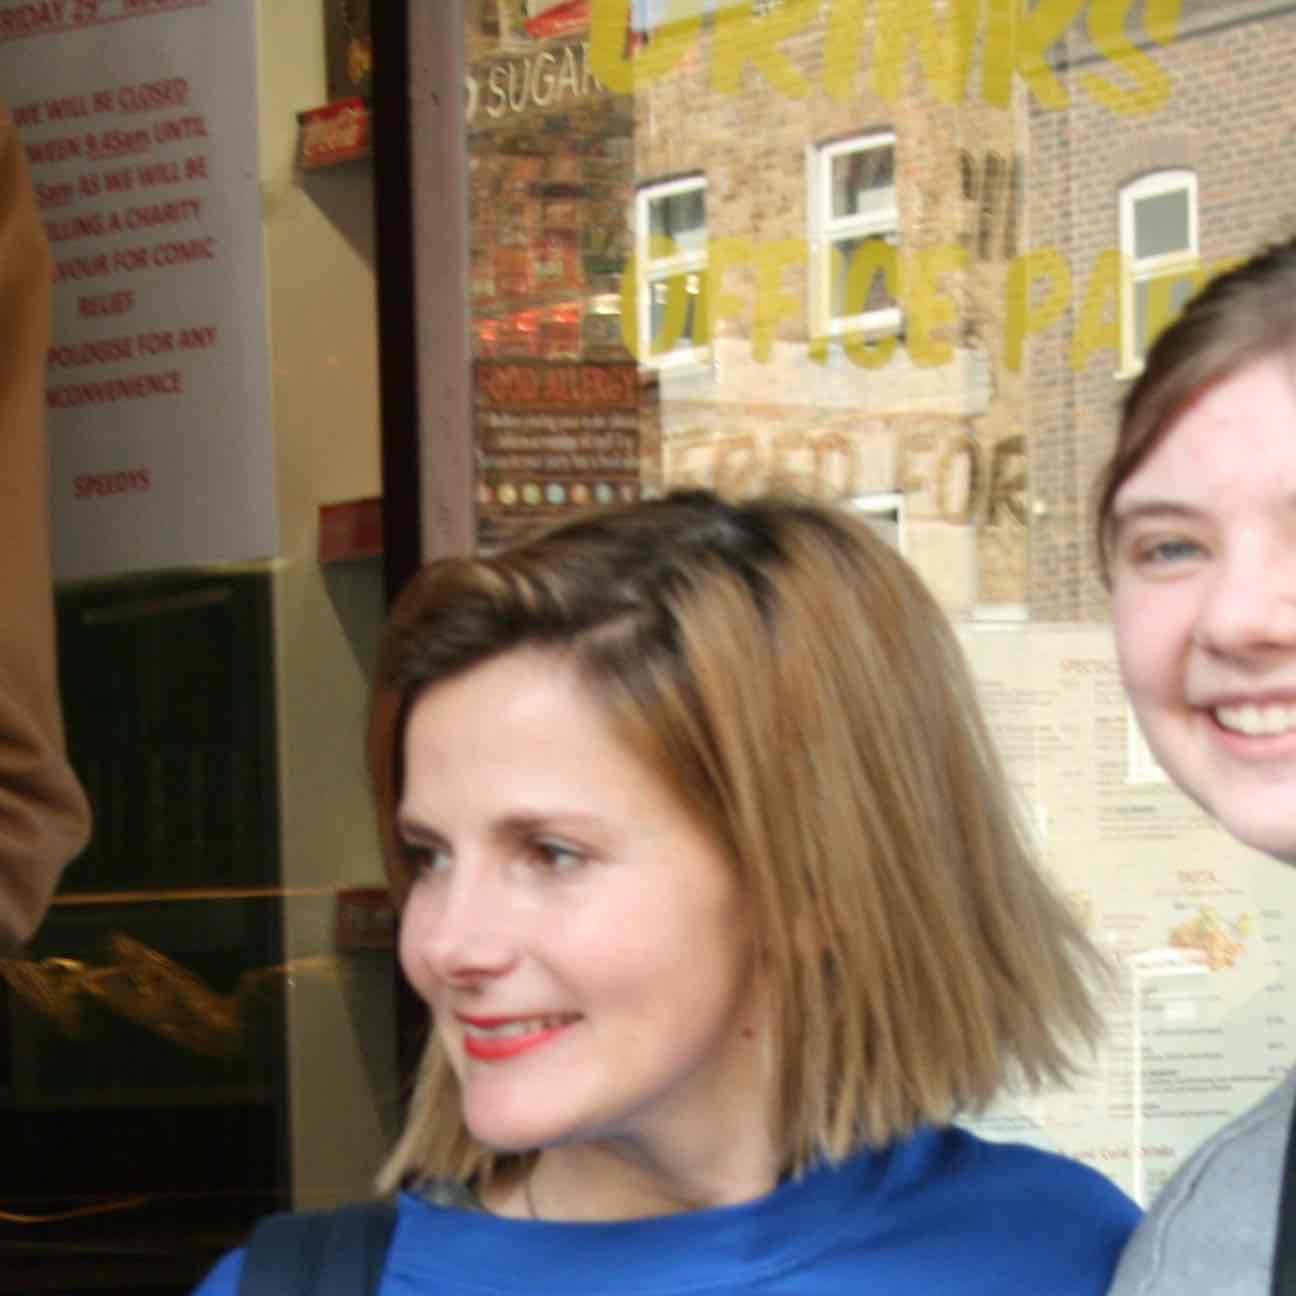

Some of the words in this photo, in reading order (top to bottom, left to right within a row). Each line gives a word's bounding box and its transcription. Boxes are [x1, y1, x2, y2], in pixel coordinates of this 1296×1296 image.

[13, 104, 42, 127] WE
[47, 94, 90, 120] WILL
[93, 89, 115, 113] BE
[117, 77, 189, 113] CLOSED
[27, 137, 81, 165] WEEN
[152, 115, 209, 144] UNTIL
[78, 174, 101, 198] AS
[103, 167, 134, 192] WE
[137, 160, 181, 187] WILL
[184, 156, 209, 180] BE
[108, 208, 124, 232] A
[125, 198, 202, 230] CHARITY
[111, 246, 151, 273] FOR
[152, 237, 218, 267] COMIC
[78, 291, 134, 318] RELIEF
[621, 236, 968, 369] OFFICE
[46, 337, 133, 370] POLOGISE
[136, 330, 176, 359] FOR
[178, 325, 218, 352] ANY
[46, 371, 181, 407] NCONVENIENCE
